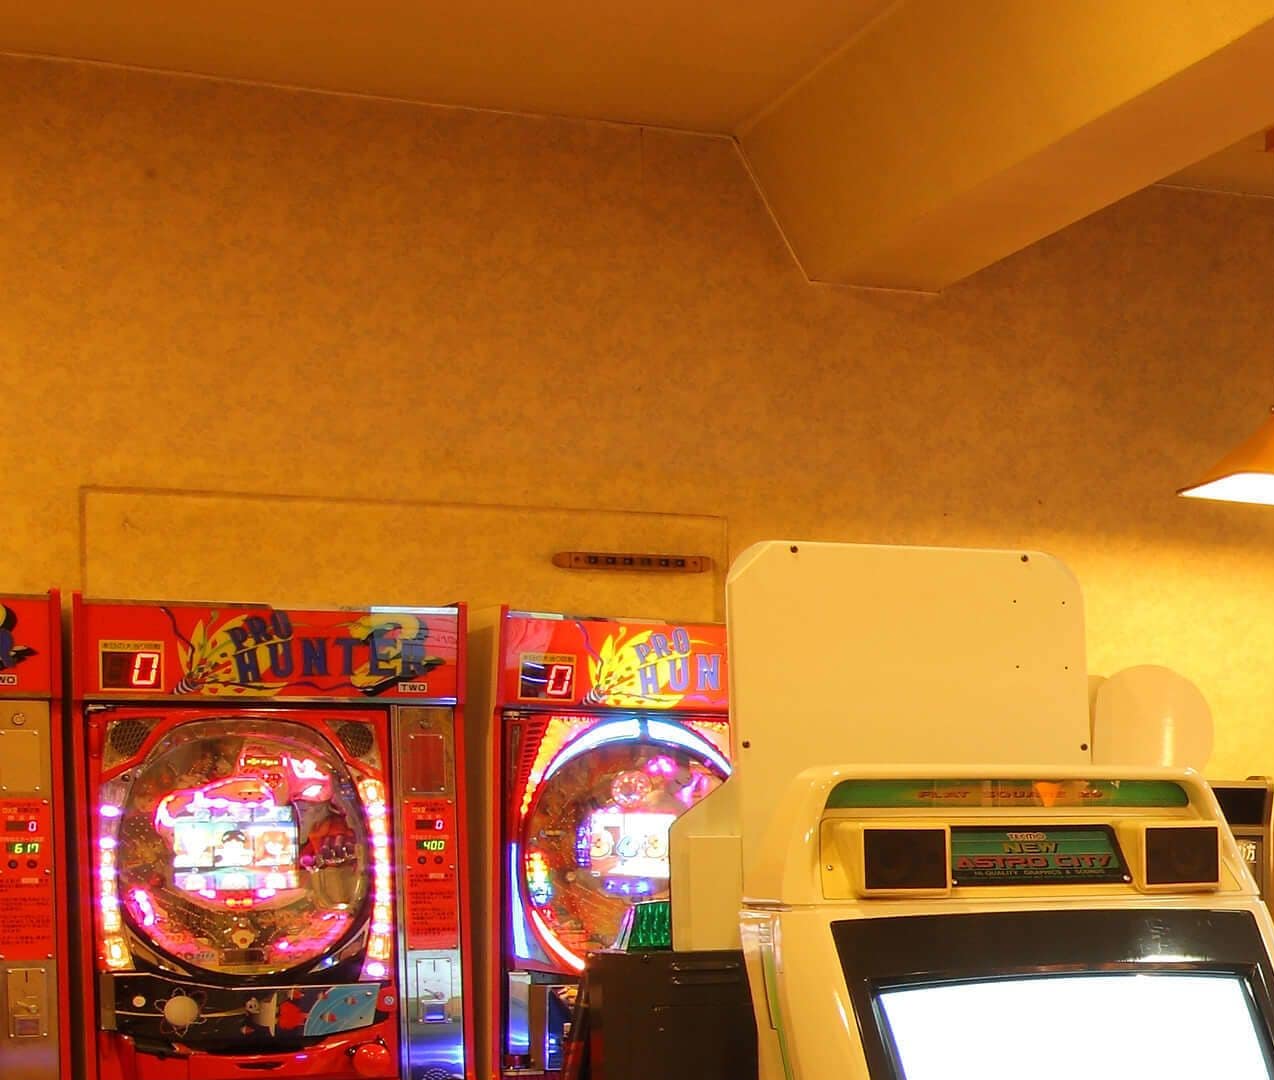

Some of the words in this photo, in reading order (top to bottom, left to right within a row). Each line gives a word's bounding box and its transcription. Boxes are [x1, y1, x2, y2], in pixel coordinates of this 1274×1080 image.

[227, 609, 294, 650] PRO
[634, 627, 691, 662] PRO
[132, 652, 159, 686] 0
[231, 635, 433, 685] HUNTER
[638, 653, 723, 696] HUN
[400, 684, 426, 692] TWO
[546, 665, 572, 695] 0
[423, 840, 445, 851] 400
[956, 855, 1049, 869] ASTRO
[1054, 854, 1113, 869] CITY
[1003, 841, 1059, 854] NEW
